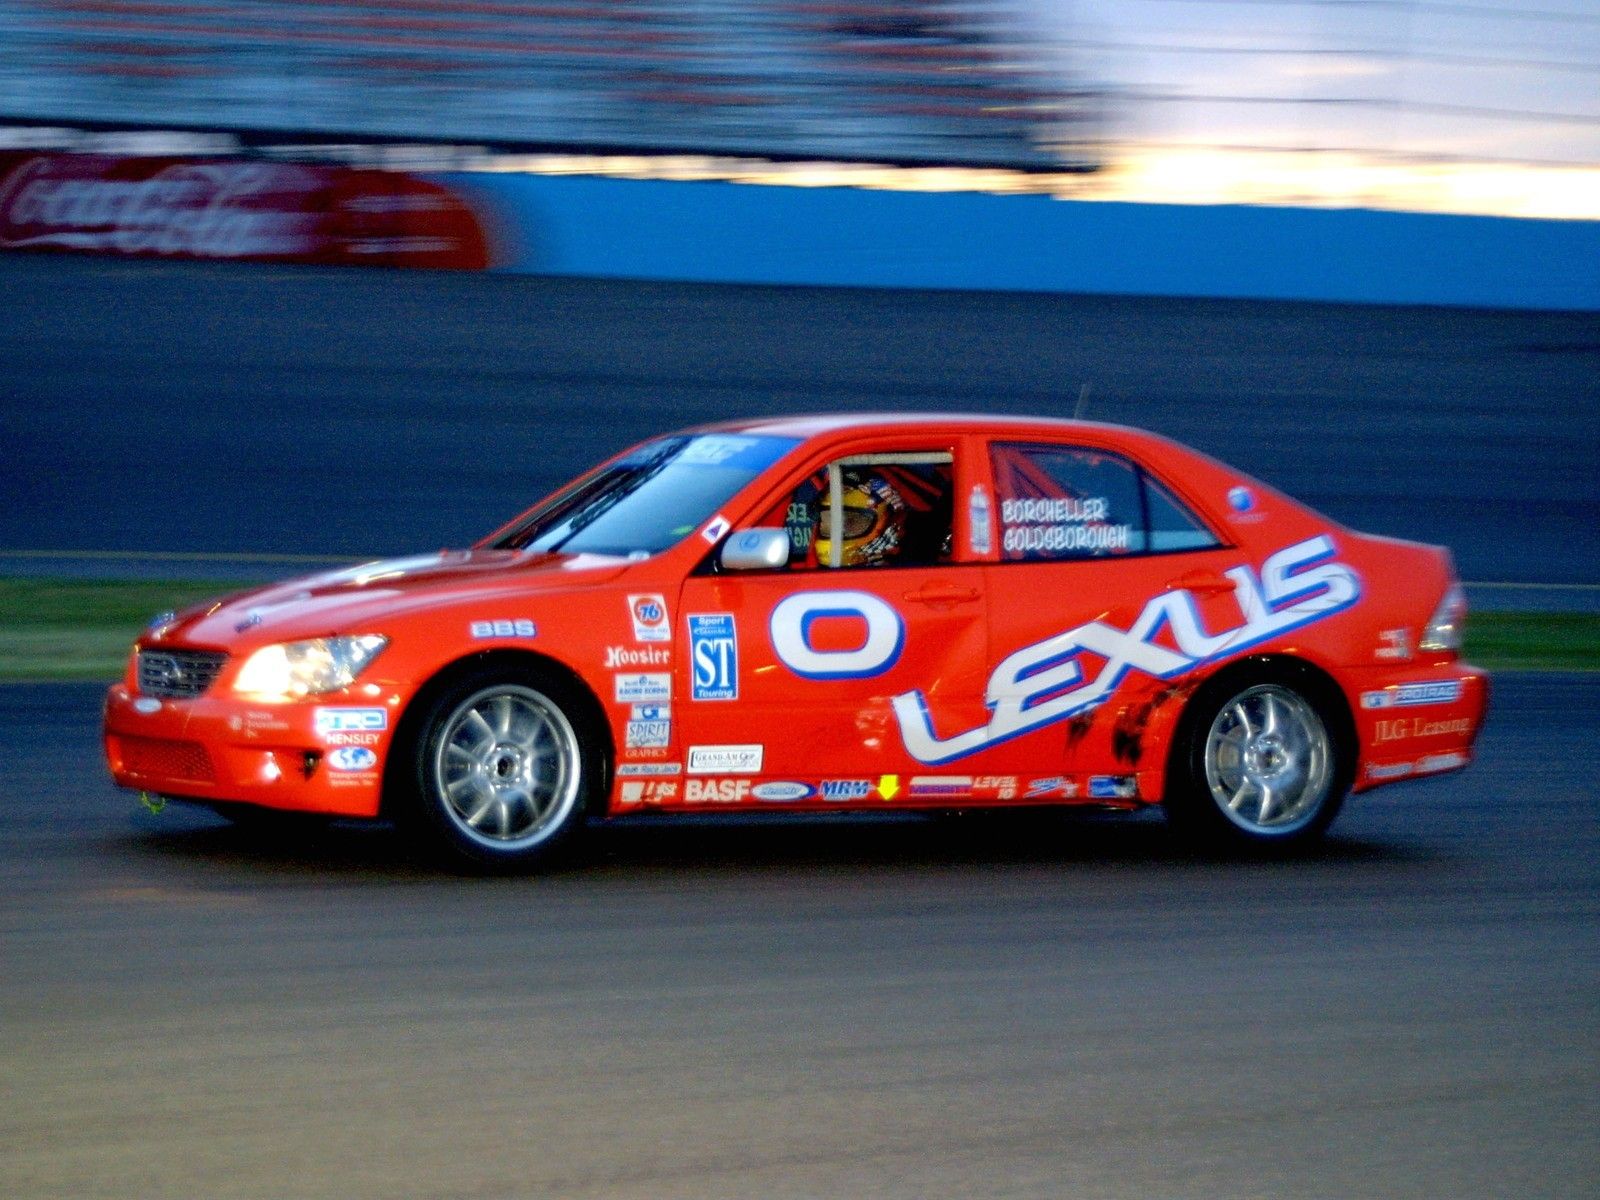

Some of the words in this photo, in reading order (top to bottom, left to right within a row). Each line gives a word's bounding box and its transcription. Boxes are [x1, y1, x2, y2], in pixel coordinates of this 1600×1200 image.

[1003, 525, 1127, 550] GOLDSBOROUGH
[640, 605, 660, 620] 76
[698, 616, 725, 628] Sport
[604, 643, 670, 667] Hoosier
[892, 534, 1360, 764] LEXUS
[695, 638, 734, 688] ST
[698, 688, 734, 699] Touring
[326, 733, 381, 745] HENSLEY
[685, 779, 751, 802] BASF
